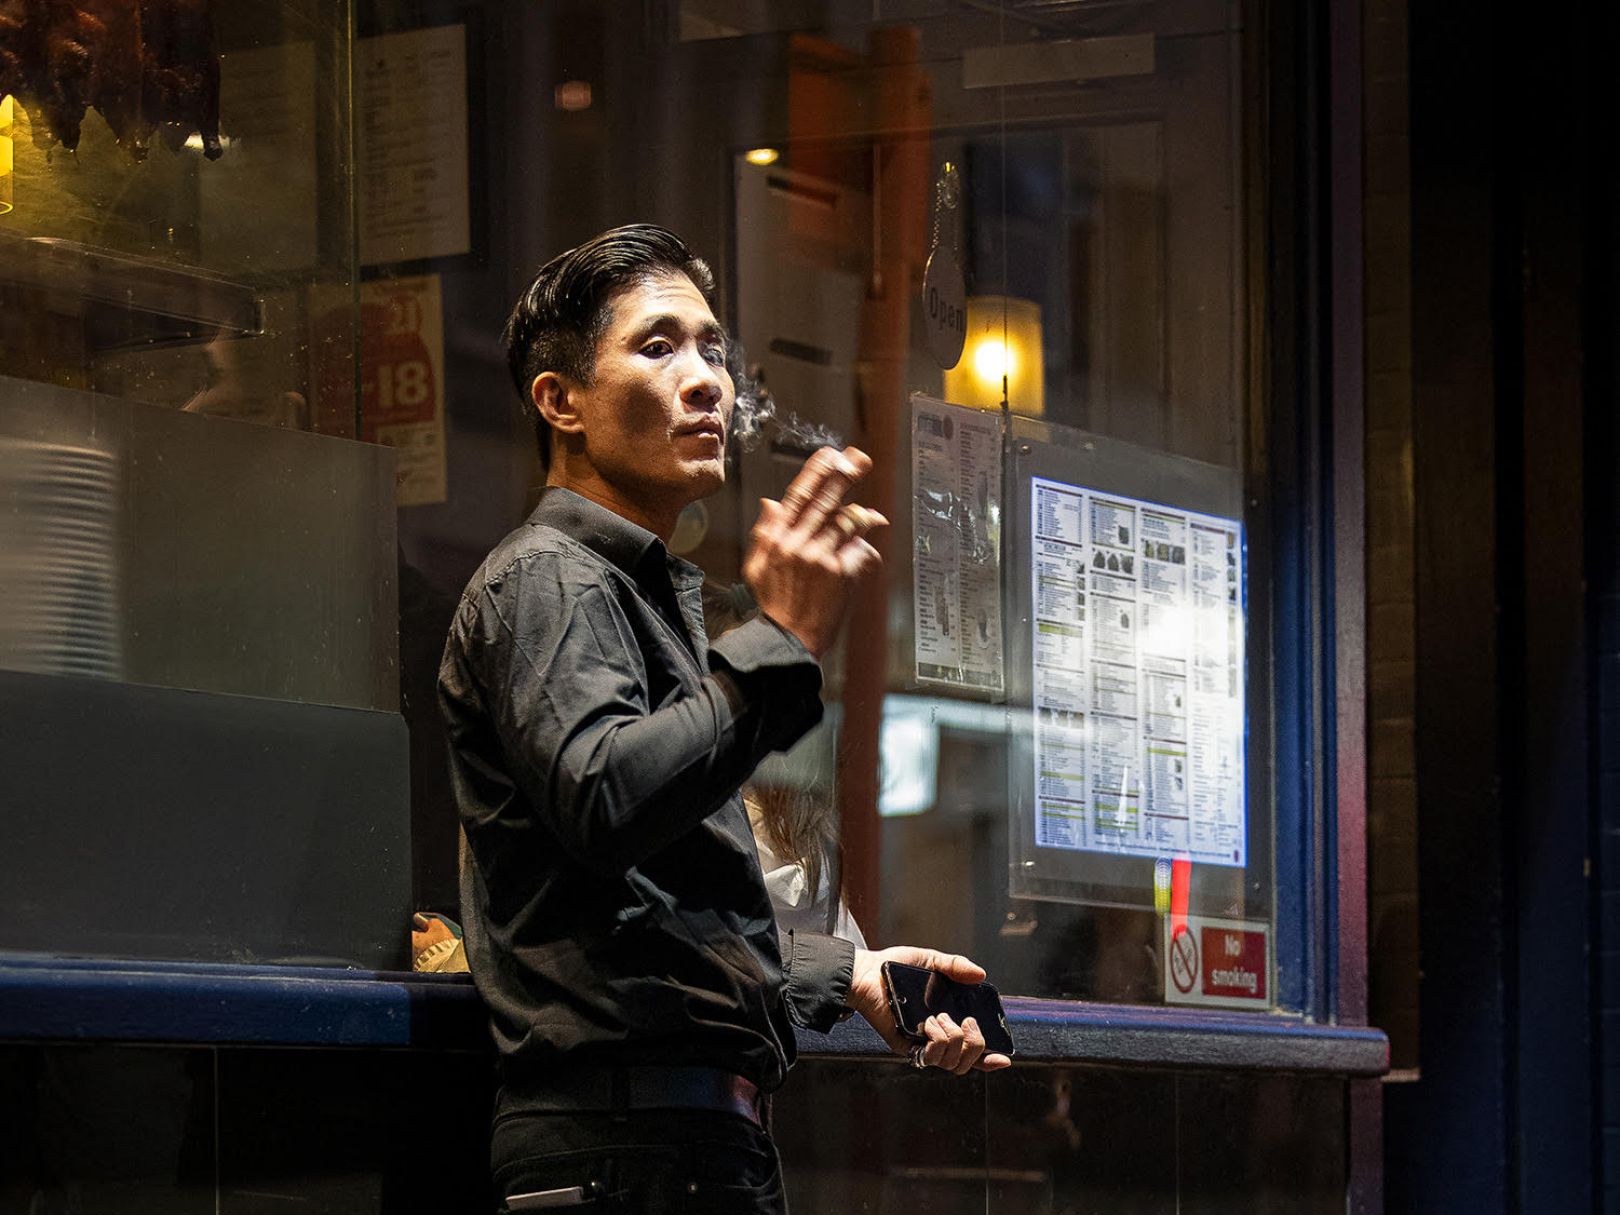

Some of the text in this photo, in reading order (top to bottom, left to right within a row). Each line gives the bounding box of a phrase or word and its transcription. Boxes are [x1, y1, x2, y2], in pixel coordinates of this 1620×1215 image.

[930, 287, 964, 332] Open
[1224, 934, 1241, 956] No
[1211, 966, 1257, 994] smoking
